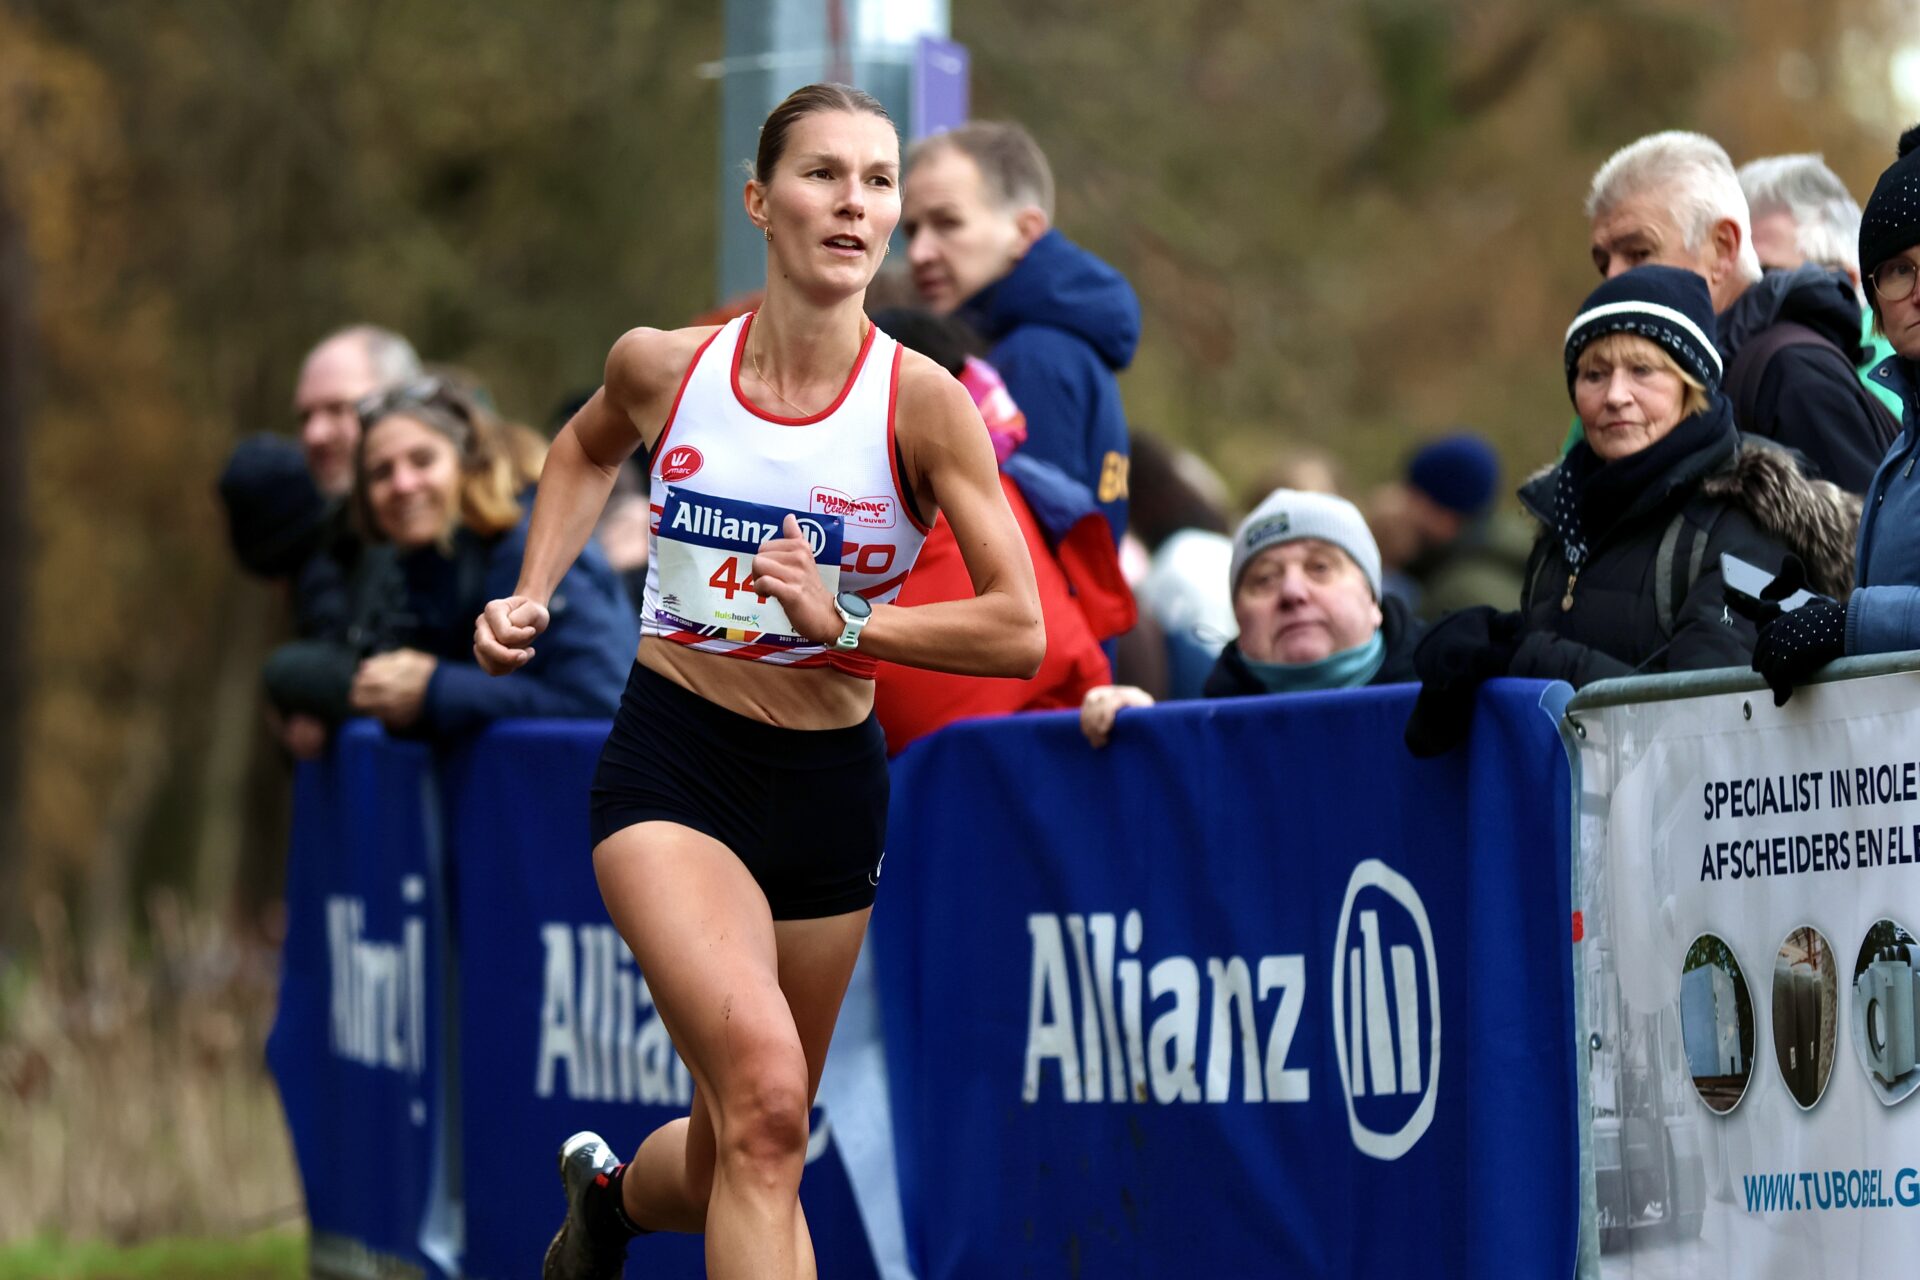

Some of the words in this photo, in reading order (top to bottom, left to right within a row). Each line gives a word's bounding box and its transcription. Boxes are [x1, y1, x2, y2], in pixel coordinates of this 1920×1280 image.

[671, 500, 779, 544] Allianz
[1702, 772, 1824, 821] SPECIALIST
[1830, 768, 1852, 809] IN
[1855, 762, 1920, 806] RIOLE
[1700, 830, 1851, 881] AFSCHEIDERS
[1855, 828, 1883, 868] EN
[1021, 908, 1311, 1104] Allianz
